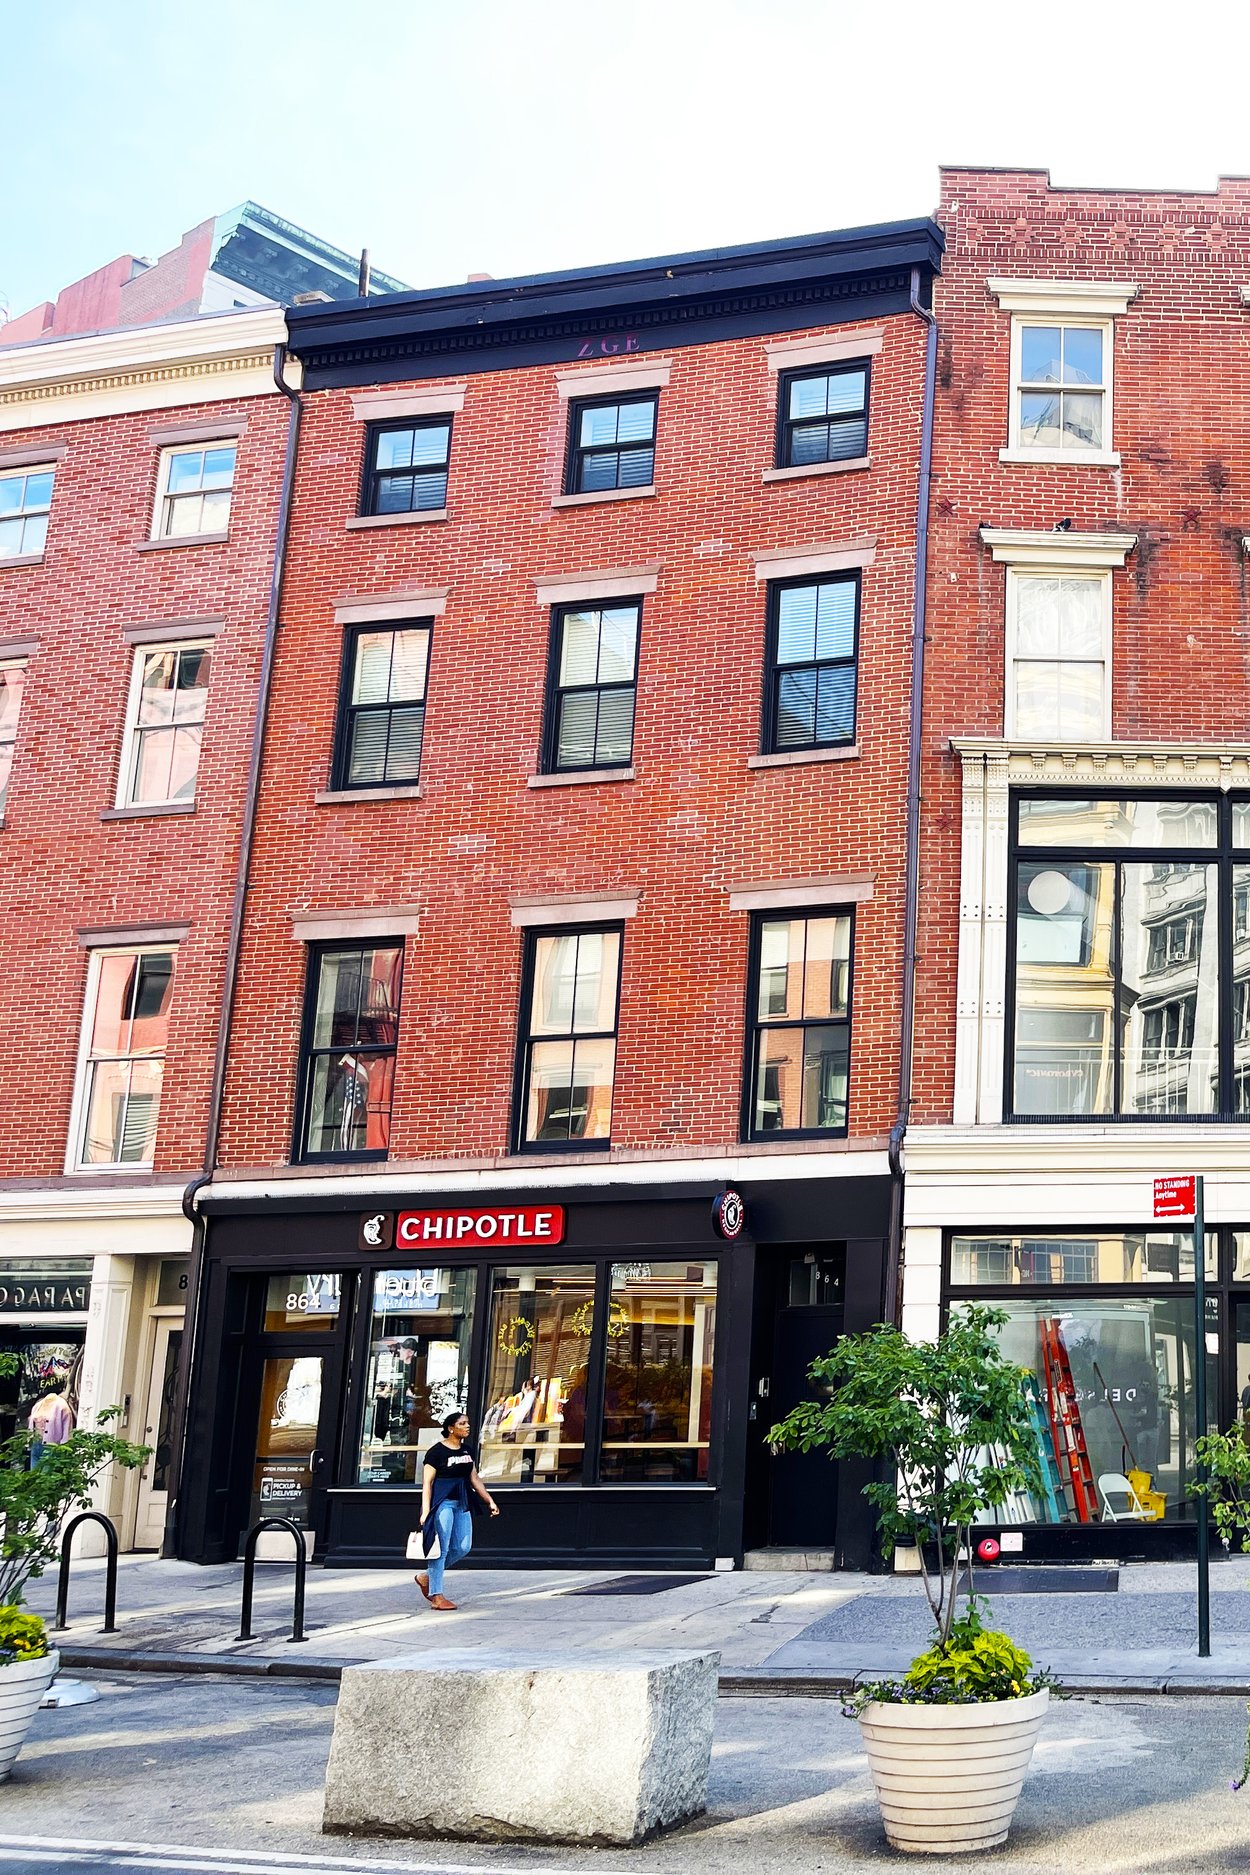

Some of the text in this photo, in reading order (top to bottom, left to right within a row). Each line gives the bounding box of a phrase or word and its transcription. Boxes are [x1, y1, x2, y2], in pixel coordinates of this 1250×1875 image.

[1154, 1179, 1190, 1190] NO STANDING
[1155, 1190, 1177, 1200] Anytime
[400, 1212, 553, 1241] CHIPOTLE
[815, 1271, 839, 1288] 864
[285, 1292, 321, 1311] 864
[273, 1482, 302, 1490] PICKUP &
[272, 1490, 303, 1498] DELIVERY
